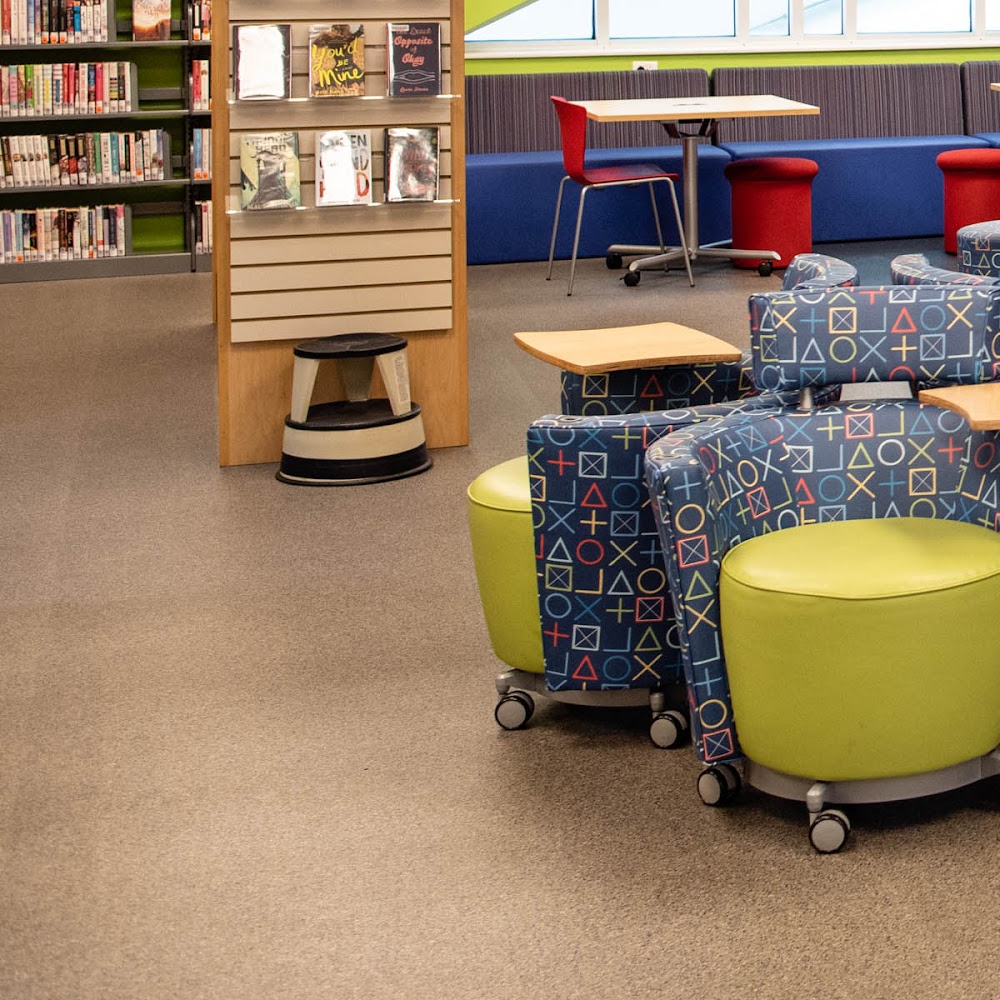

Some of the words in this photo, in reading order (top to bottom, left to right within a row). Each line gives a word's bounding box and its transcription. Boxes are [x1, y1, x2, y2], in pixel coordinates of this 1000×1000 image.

[394, 36, 433, 48] Opposite
[311, 36, 358, 72] You'd
[402, 53, 425, 67] Okay
[319, 68, 365, 87] Mine
